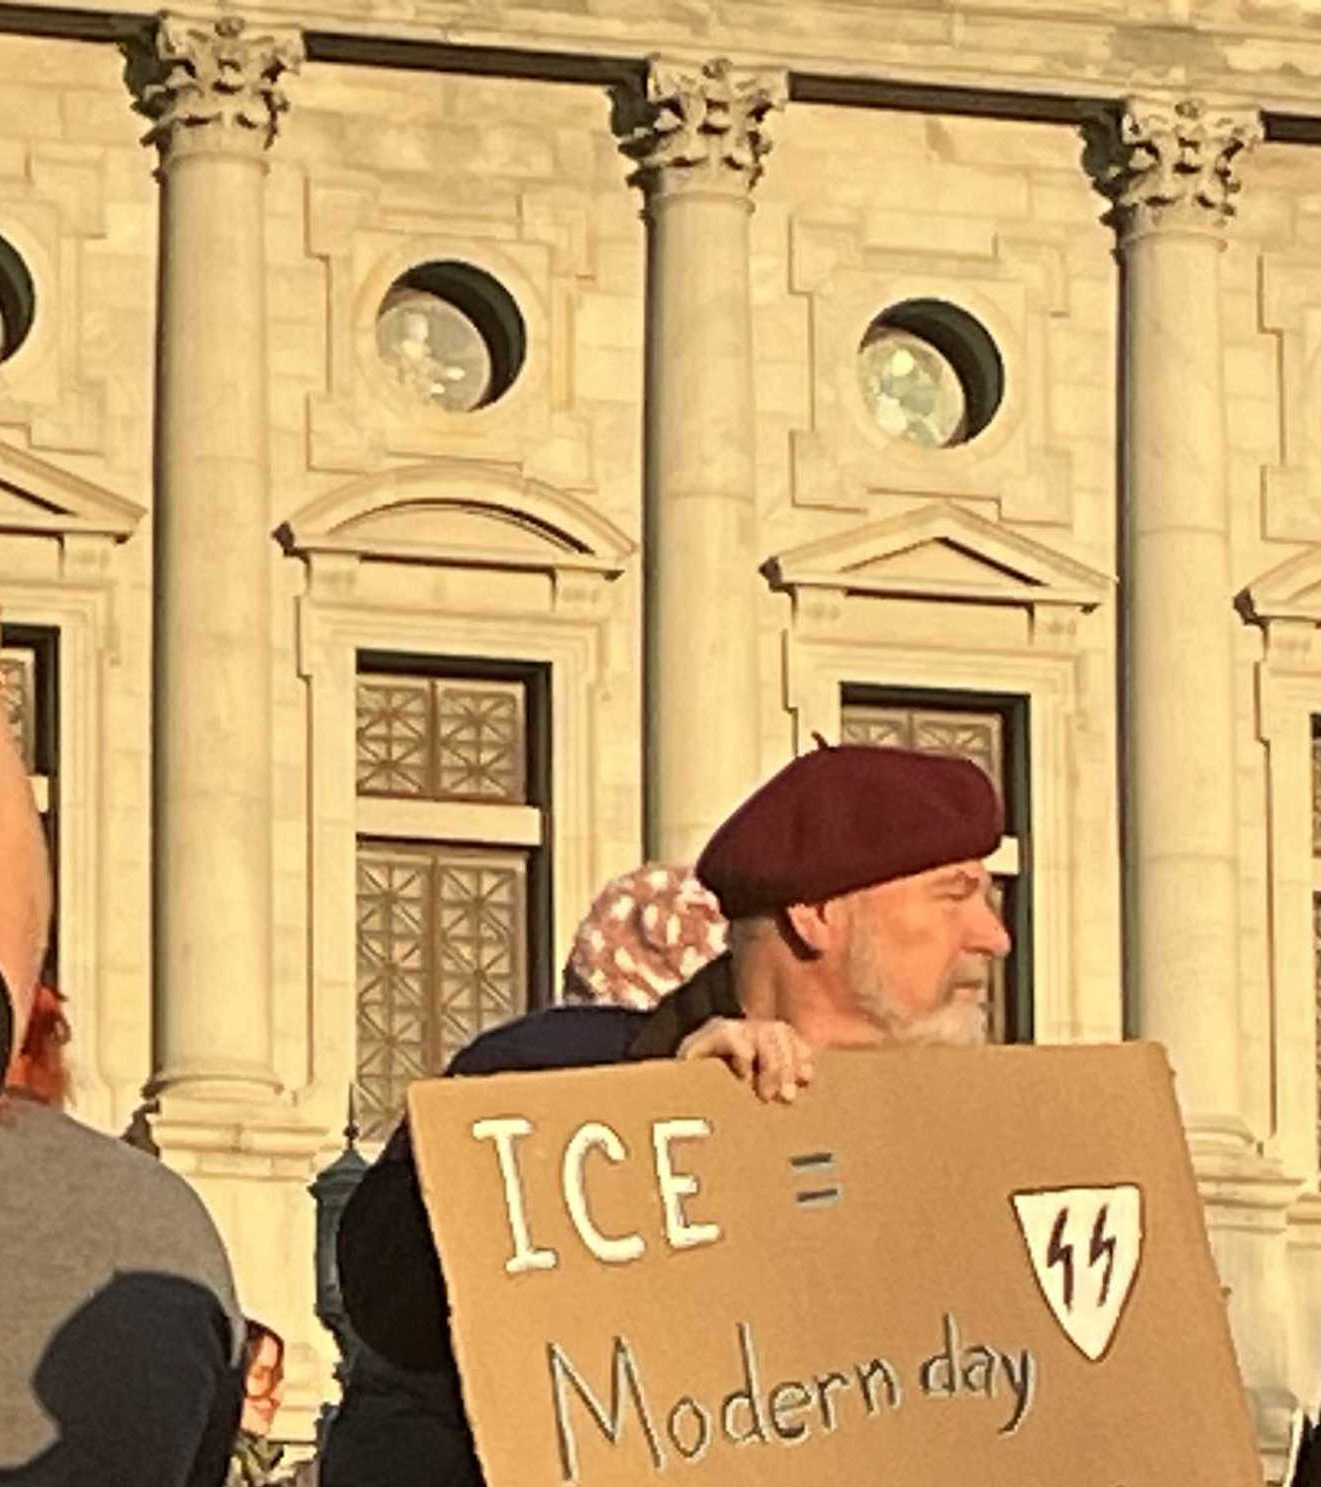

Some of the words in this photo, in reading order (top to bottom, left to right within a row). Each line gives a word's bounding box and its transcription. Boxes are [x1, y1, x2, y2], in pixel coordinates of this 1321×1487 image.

[471, 1115, 724, 1275] ICE
[546, 1322, 900, 1487] Modern
[918, 1312, 1037, 1436] day
